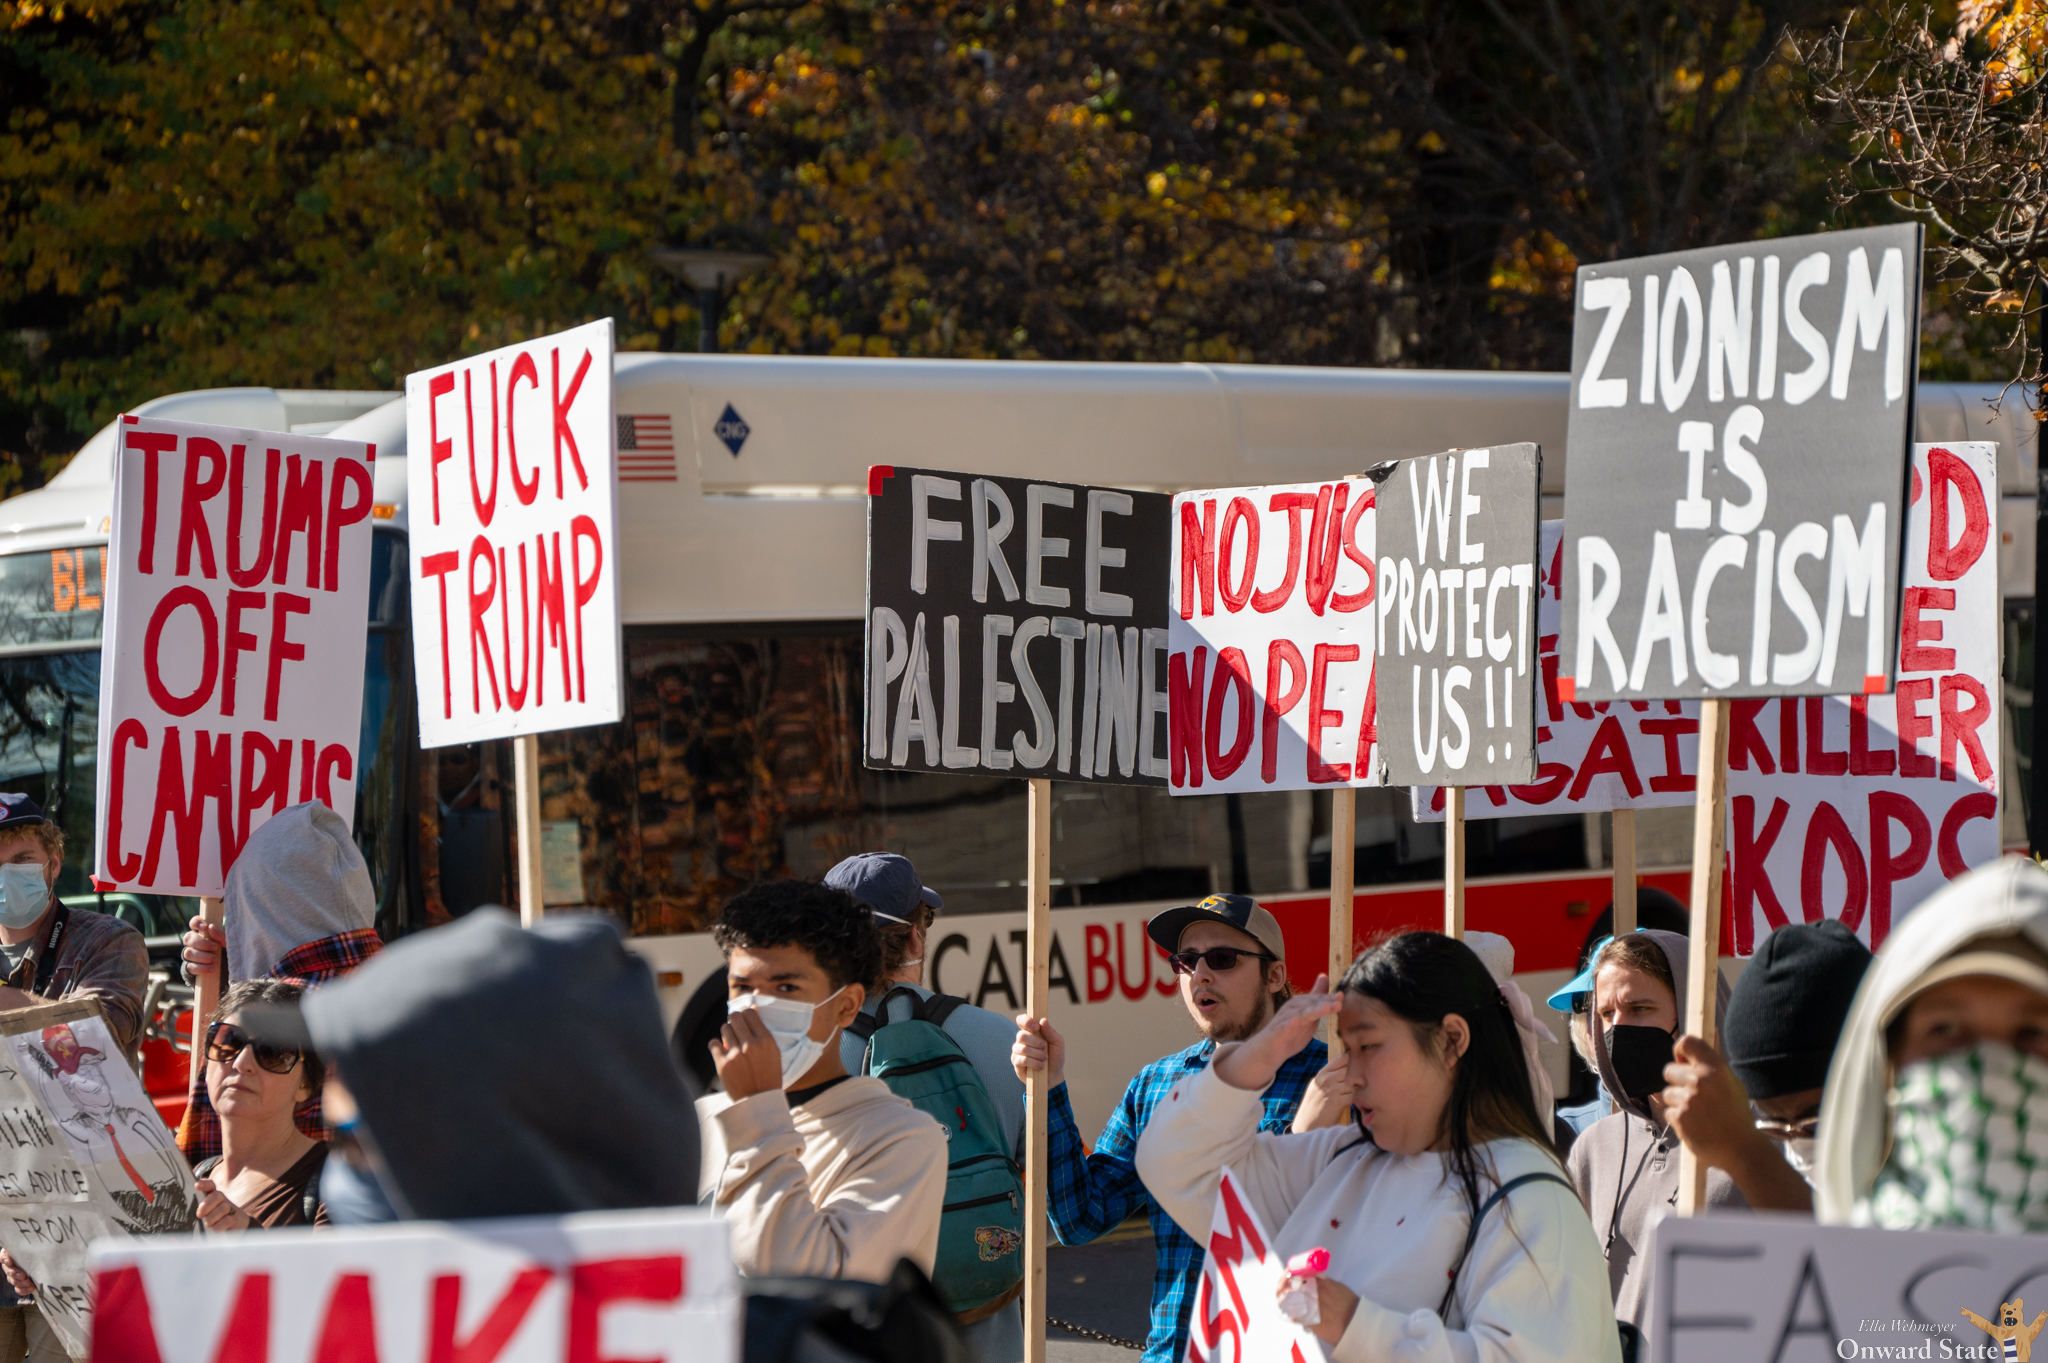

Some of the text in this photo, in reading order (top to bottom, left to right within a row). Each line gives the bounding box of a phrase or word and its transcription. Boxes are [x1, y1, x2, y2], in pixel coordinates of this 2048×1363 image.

[1578, 247, 1904, 412] ZIONISM
[428, 347, 592, 526] FUCK
[717, 420, 747, 439] CNG
[1675, 405, 1767, 535] IS
[126, 431, 374, 592] TRUMP
[911, 475, 1133, 617] FREE
[1410, 449, 1490, 566] WE
[144, 585, 310, 721] OFF
[420, 515, 602, 720] TRUMP
[1378, 557, 1533, 677] PROTECT
[1576, 502, 1886, 692] RACISM
[869, 606, 1168, 779] PALESTINE
[1727, 673, 1992, 783] KILLER
[12, 1215, 88, 1248] FROM
